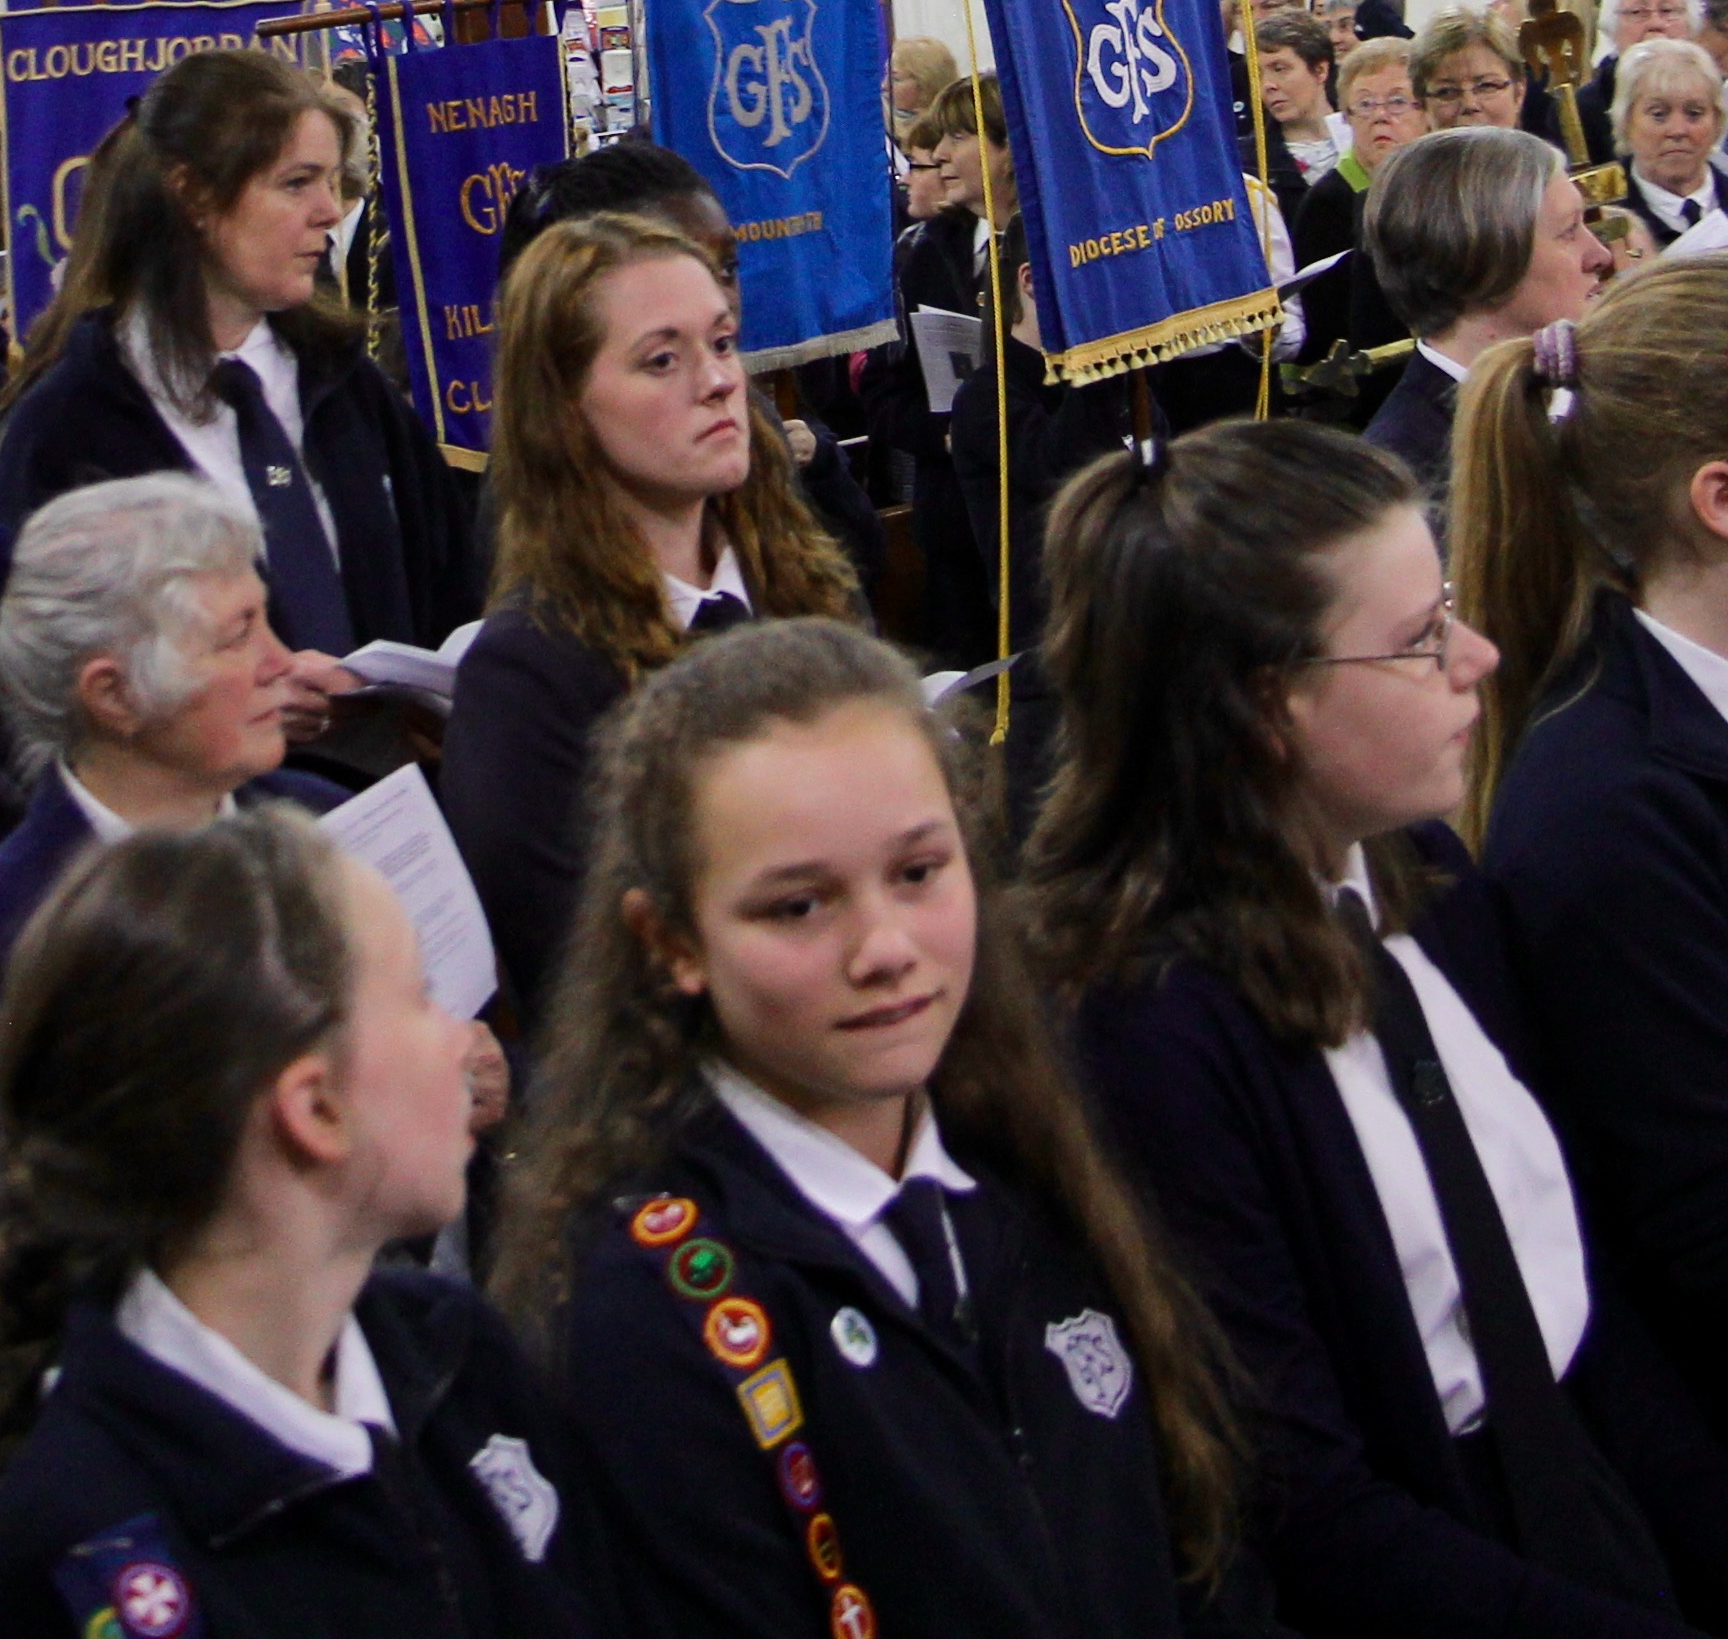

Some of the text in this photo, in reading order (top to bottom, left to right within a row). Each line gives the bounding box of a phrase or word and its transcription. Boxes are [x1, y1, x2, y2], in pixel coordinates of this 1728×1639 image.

[426, 90, 539, 134] NENAGH
[1069, 224, 1152, 268] DIOCESE
[1175, 199, 1236, 231] OSSORY
